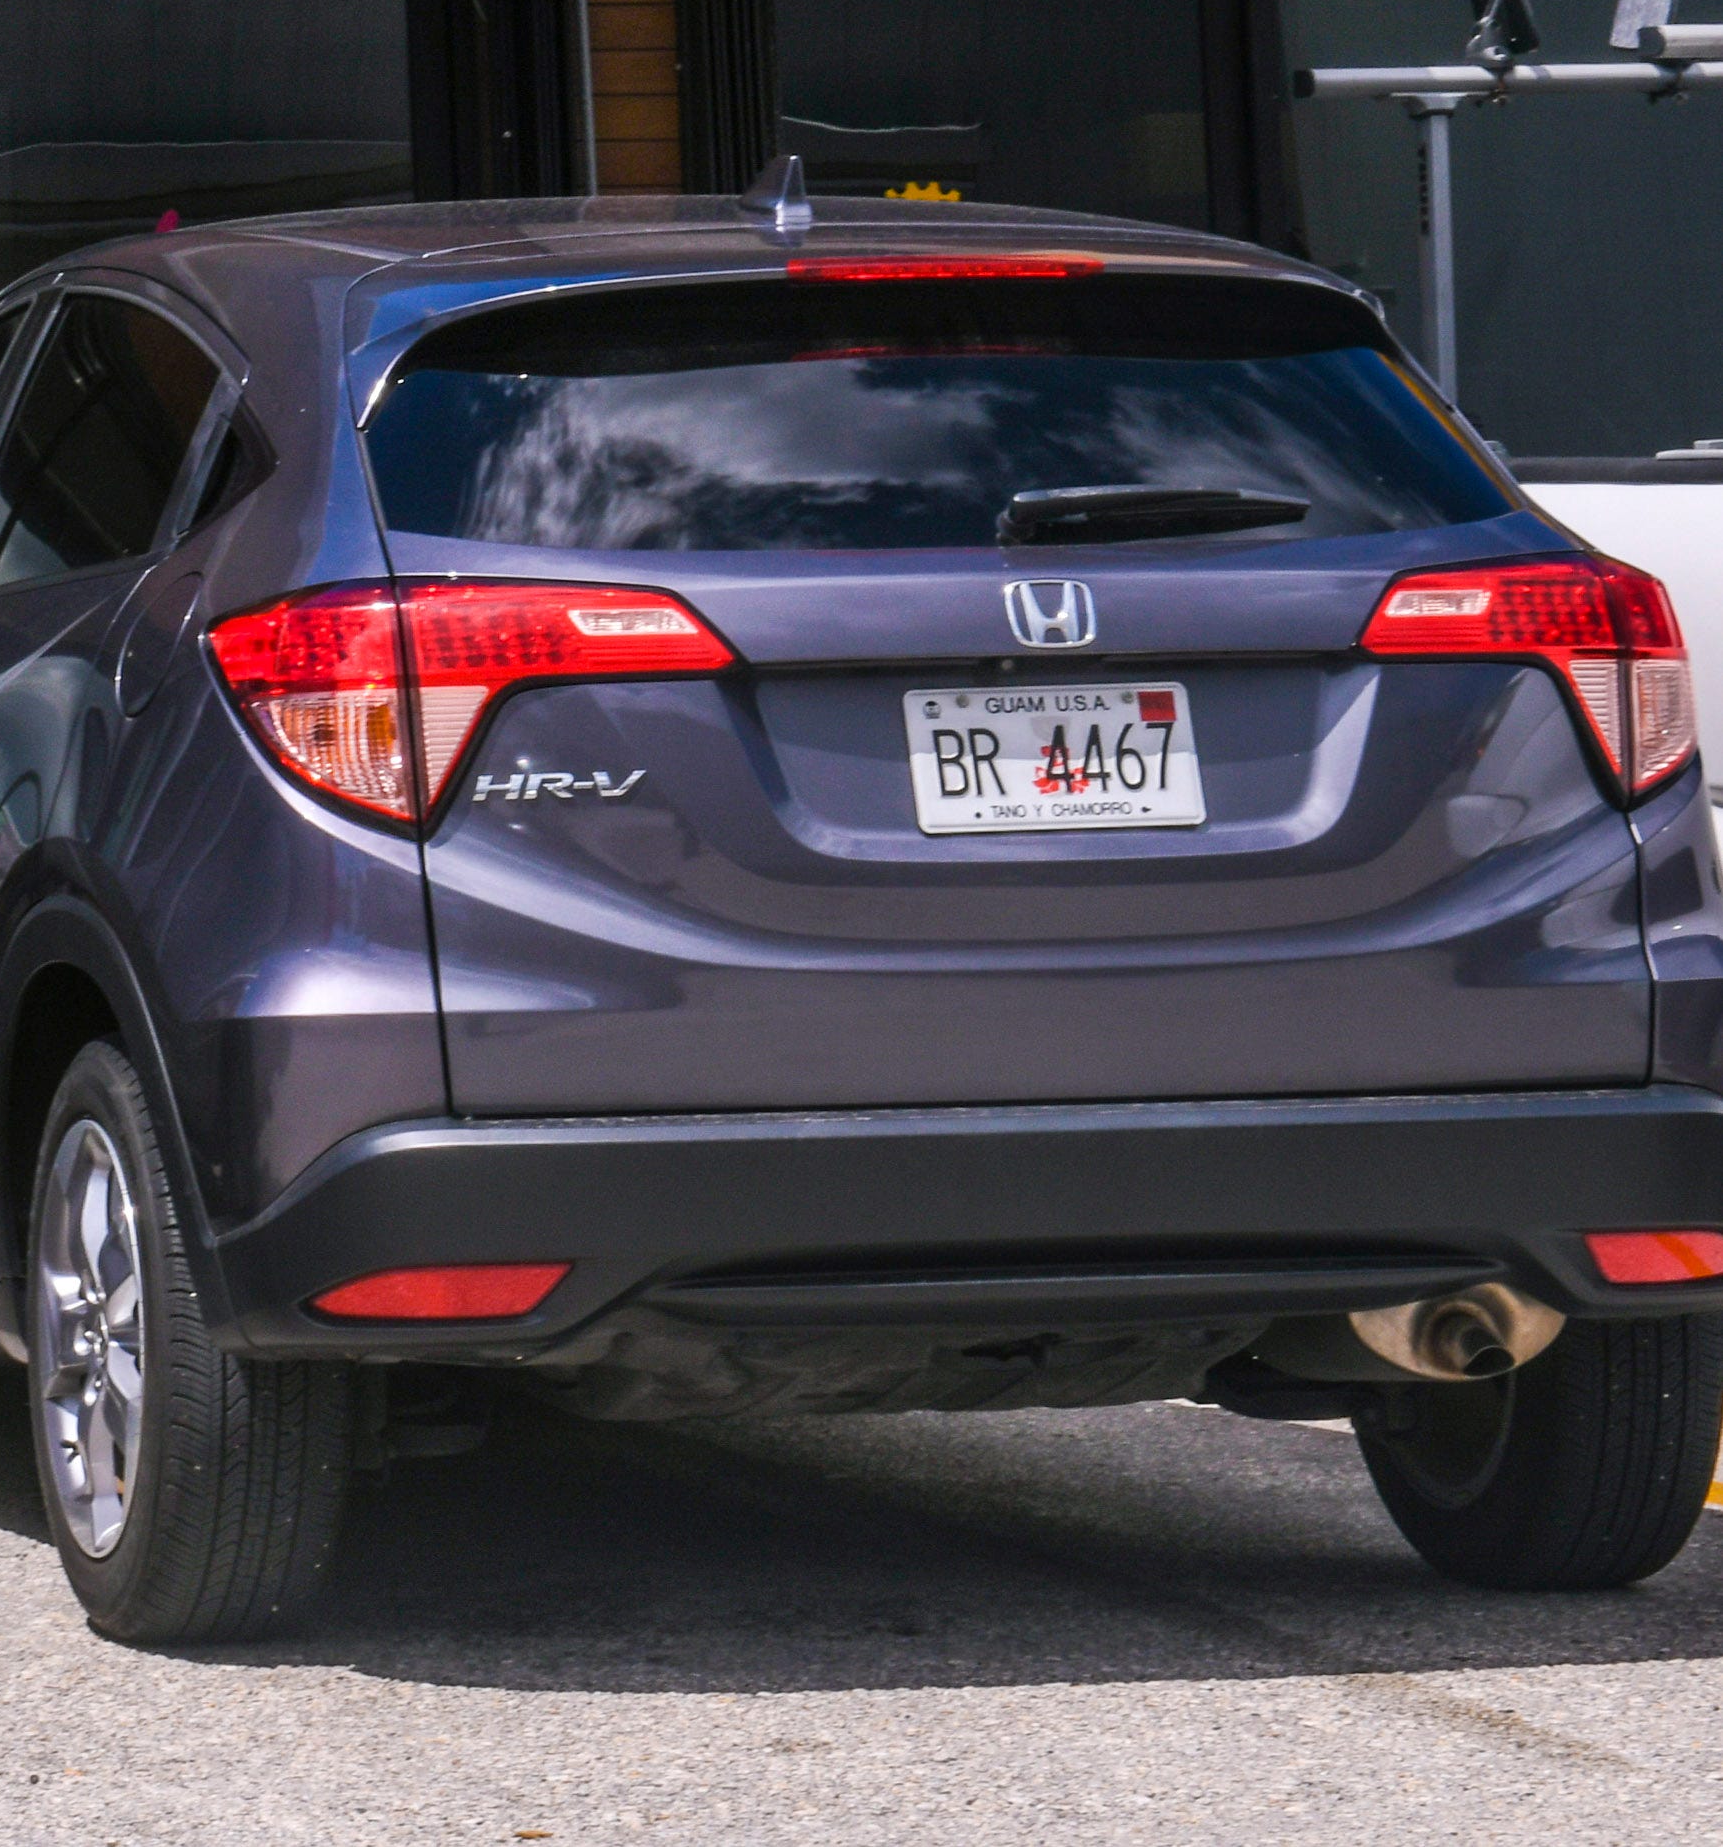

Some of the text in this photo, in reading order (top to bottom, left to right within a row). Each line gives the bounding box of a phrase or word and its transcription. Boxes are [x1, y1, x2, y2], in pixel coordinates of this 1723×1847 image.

[985, 695, 1111, 714] GUAM U.S.A.
[933, 723, 1174, 797] BR 4467
[472, 769, 647, 802] HR-V
[1033, 804, 1043, 816] Y
